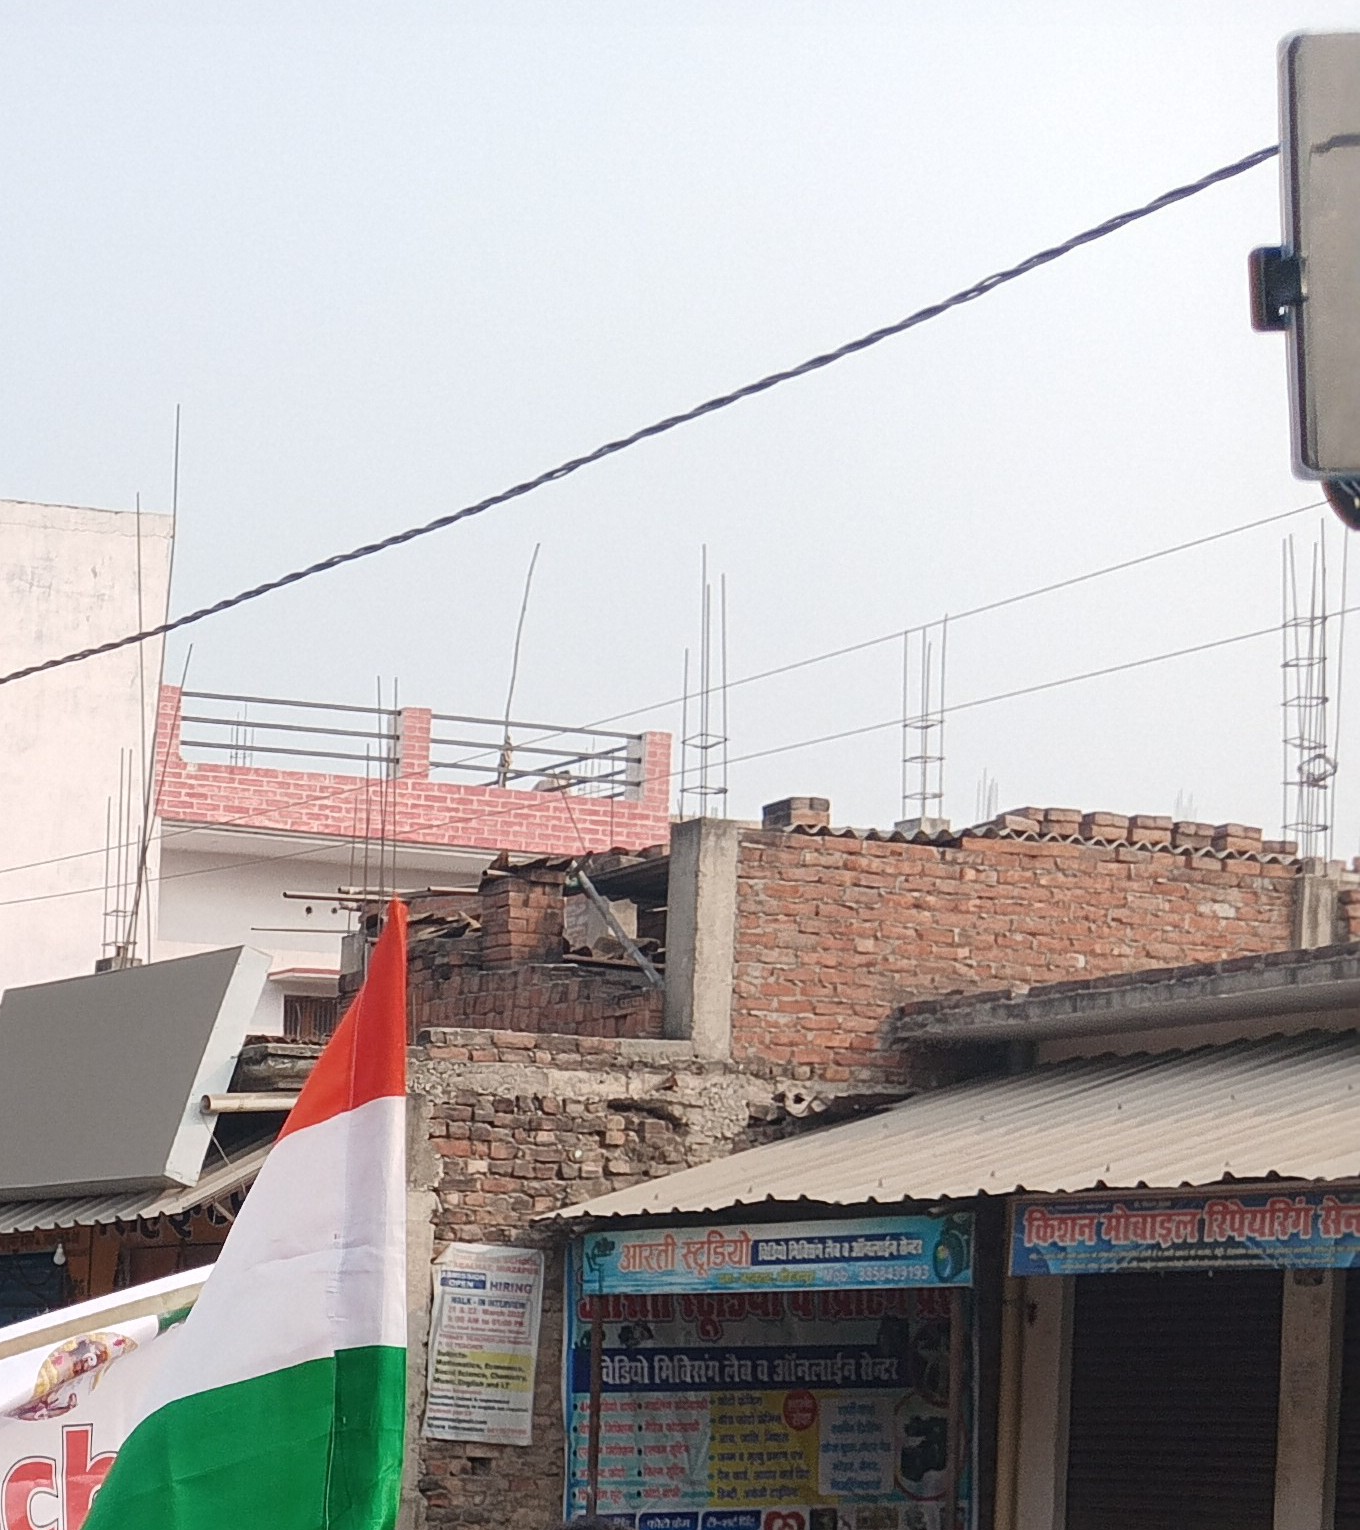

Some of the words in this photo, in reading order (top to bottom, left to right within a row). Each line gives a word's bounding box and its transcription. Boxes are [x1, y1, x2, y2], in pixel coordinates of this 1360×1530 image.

[1023, 1204, 1098, 1247] किशन
[681, 1229, 753, 1277] स्टूडियो
[490, 1281, 533, 1294] HIRING
